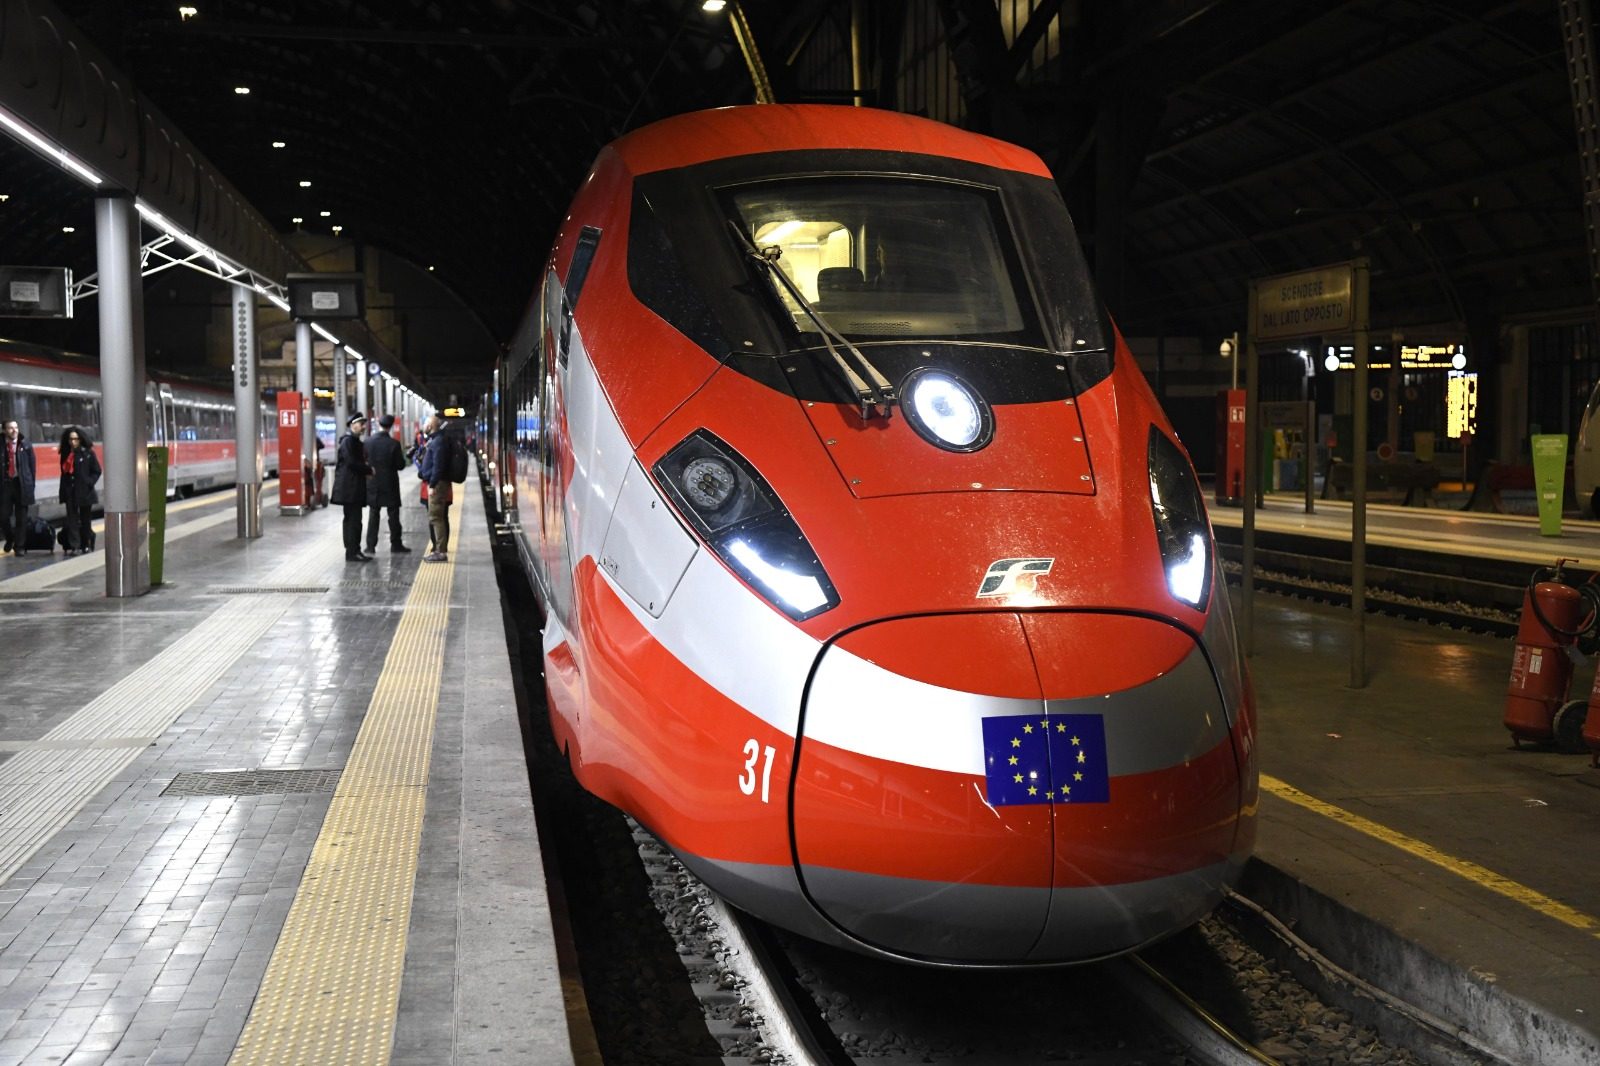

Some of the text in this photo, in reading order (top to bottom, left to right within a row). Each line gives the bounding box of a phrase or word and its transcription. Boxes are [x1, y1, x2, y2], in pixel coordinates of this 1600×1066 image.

[1281, 281, 1323, 301] SCENDERE
[1263, 303, 1343, 327] DAL LATO OPPOSTO
[739, 738, 776, 803] 31
